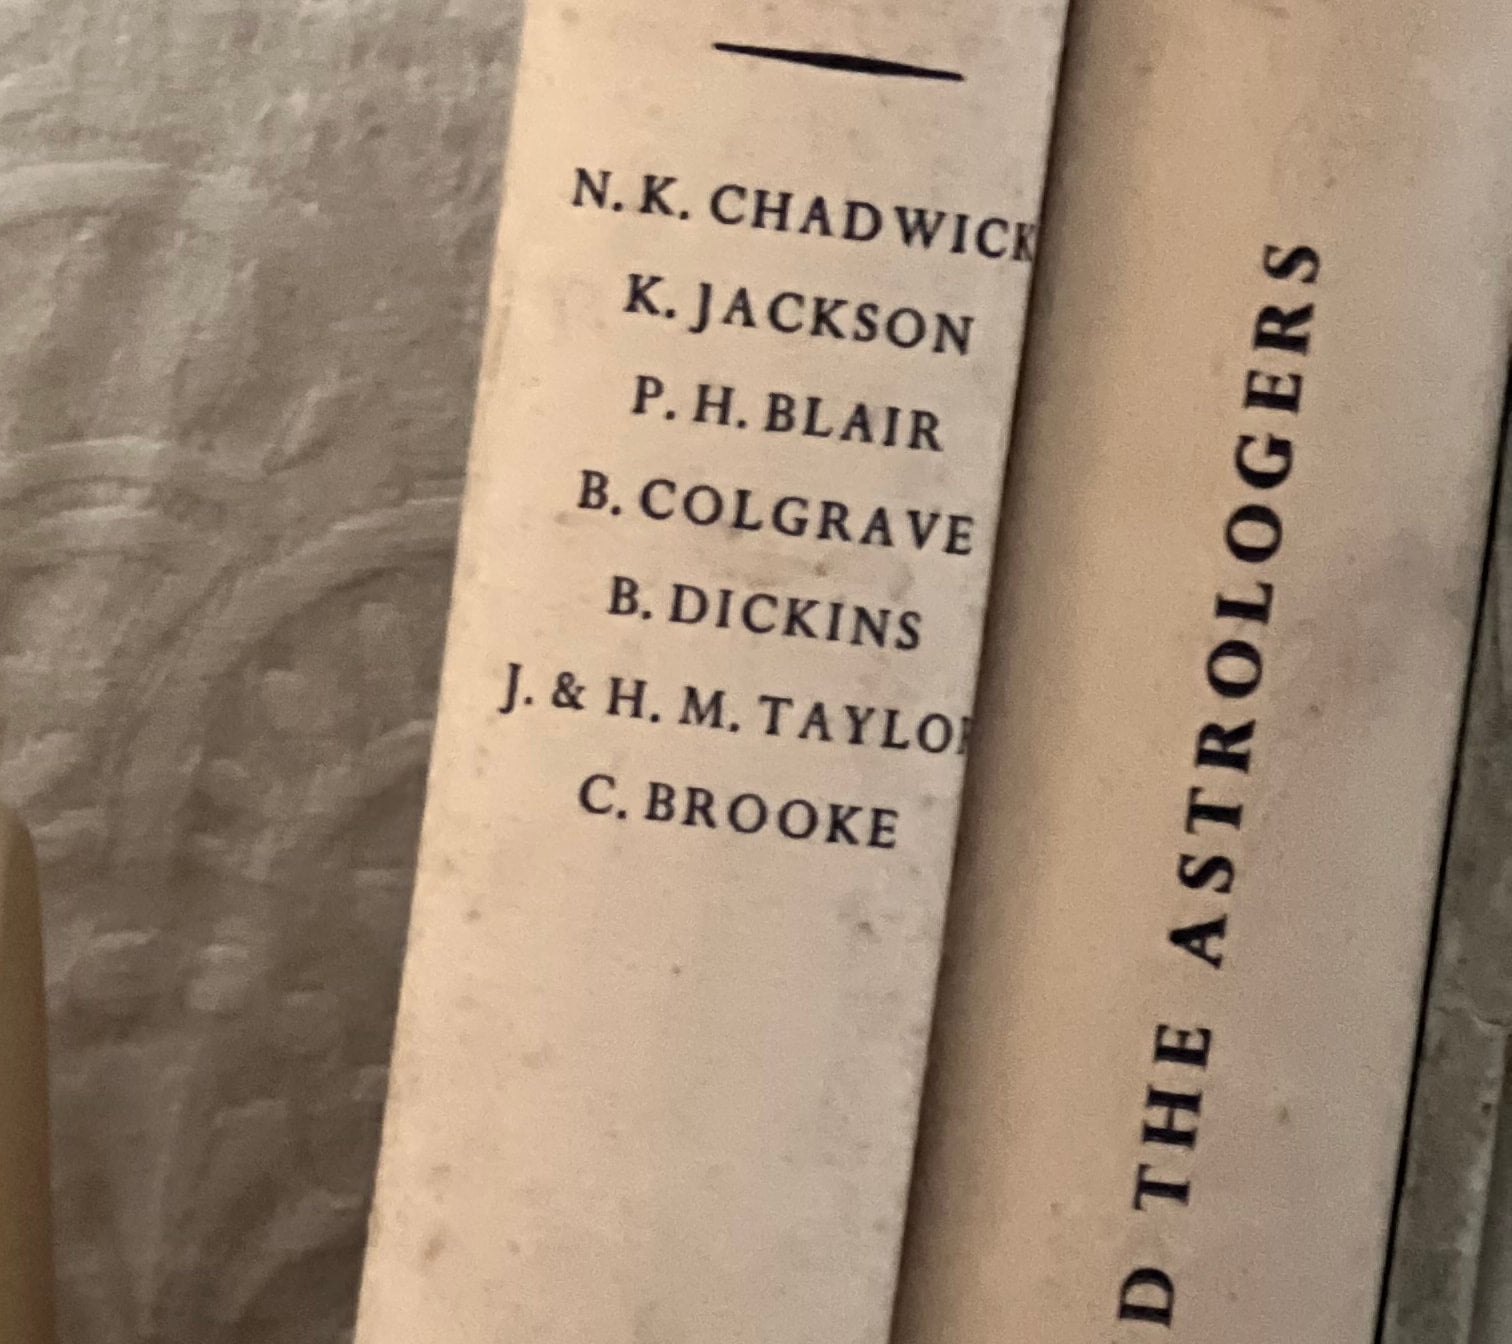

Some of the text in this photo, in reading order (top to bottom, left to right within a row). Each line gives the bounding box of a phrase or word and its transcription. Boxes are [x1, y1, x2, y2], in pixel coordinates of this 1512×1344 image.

[708, 182, 1039, 264] CHADWICK
[686, 280, 976, 357] JACKSON
[762, 390, 945, 453] BLAIR
[637, 477, 975, 557] COLGRAVE
[667, 582, 923, 653] DICKINS
[1166, 243, 1322, 972] ASTROLOGERS
[550, 670, 587, 712] &
[642, 780, 900, 851] BROOKE
[1130, 1022, 1214, 1212] THE
